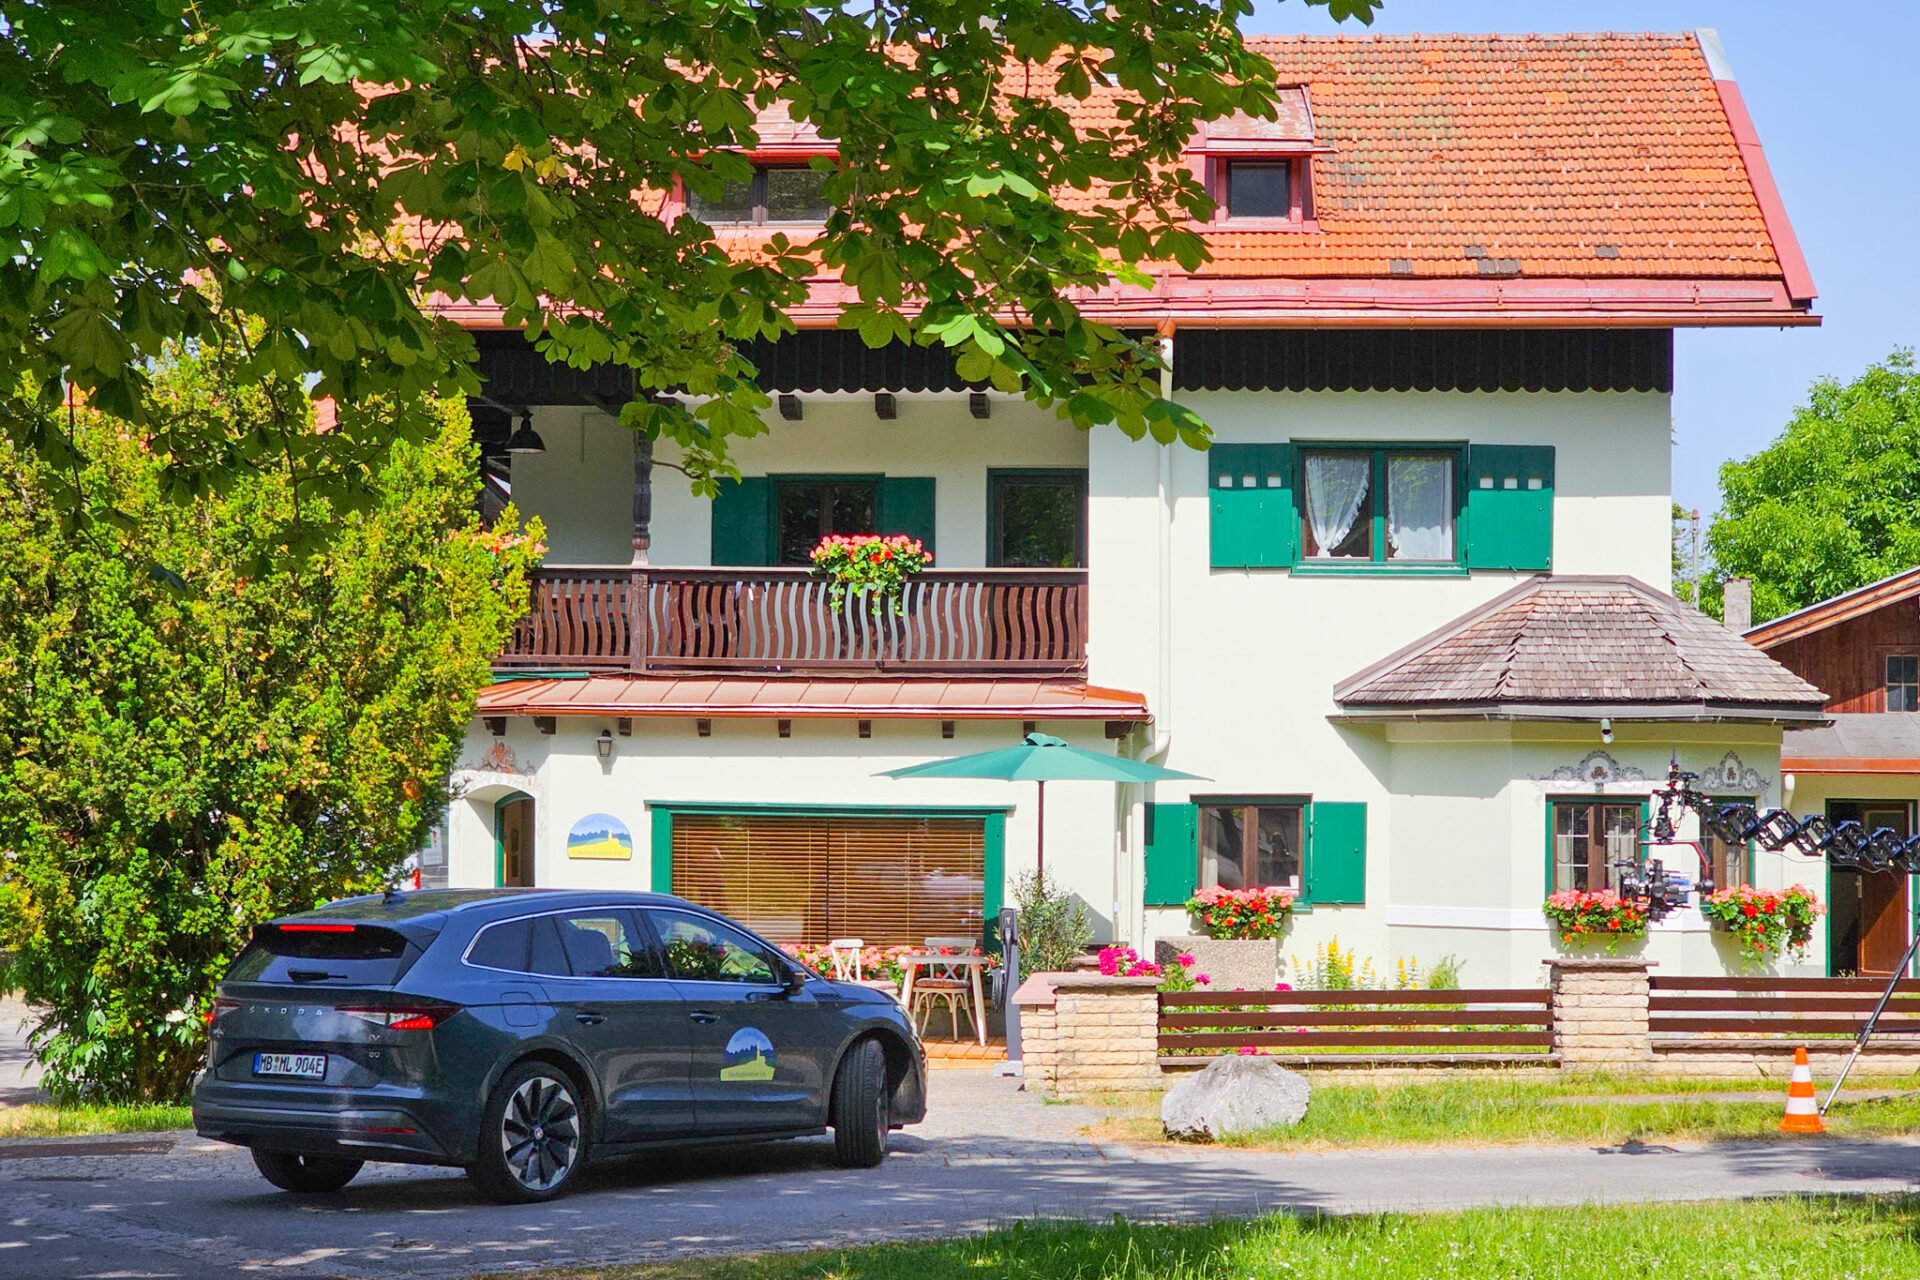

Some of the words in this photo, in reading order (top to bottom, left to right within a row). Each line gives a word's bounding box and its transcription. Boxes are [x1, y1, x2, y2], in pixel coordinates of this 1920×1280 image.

[260, 1055, 273, 1071] MB
[279, 1056, 293, 1073] ML
[295, 1056, 324, 1075] 904E
